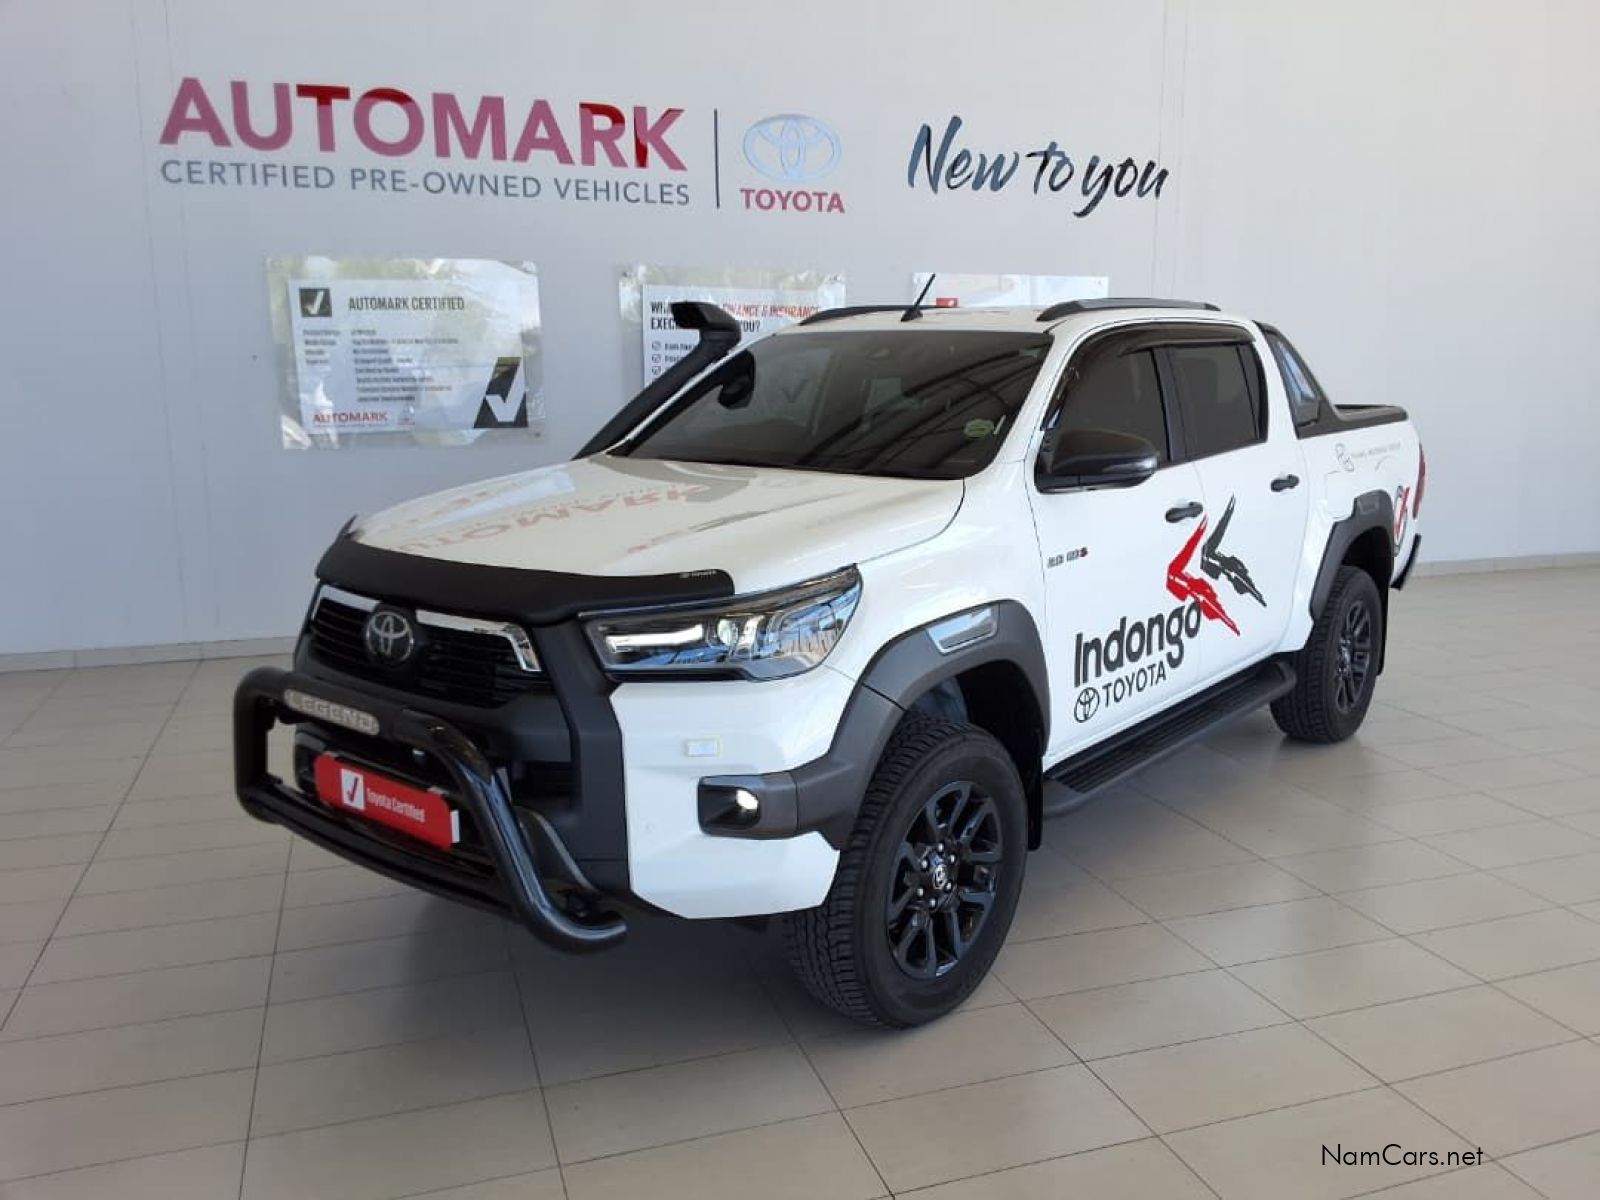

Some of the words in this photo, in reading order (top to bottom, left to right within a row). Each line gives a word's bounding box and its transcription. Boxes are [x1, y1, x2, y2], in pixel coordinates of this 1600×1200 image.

[159, 77, 688, 171] AUTOMARK
[160, 160, 334, 189] CERTIFIED
[350, 169, 542, 199] PRE-OWNED
[553, 178, 690, 206] VEHICLES
[907, 115, 1020, 194] New
[1025, 141, 1074, 194] to
[1073, 155, 1169, 218] you
[740, 188, 845, 214] TOYOTA
[348, 296, 409, 311] AUTOMARK
[411, 295, 465, 310] CERTIFIED
[313, 411, 388, 423] AUTOMARK
[1073, 601, 1202, 688] Indongo
[1101, 660, 1167, 708] TOYOTA
